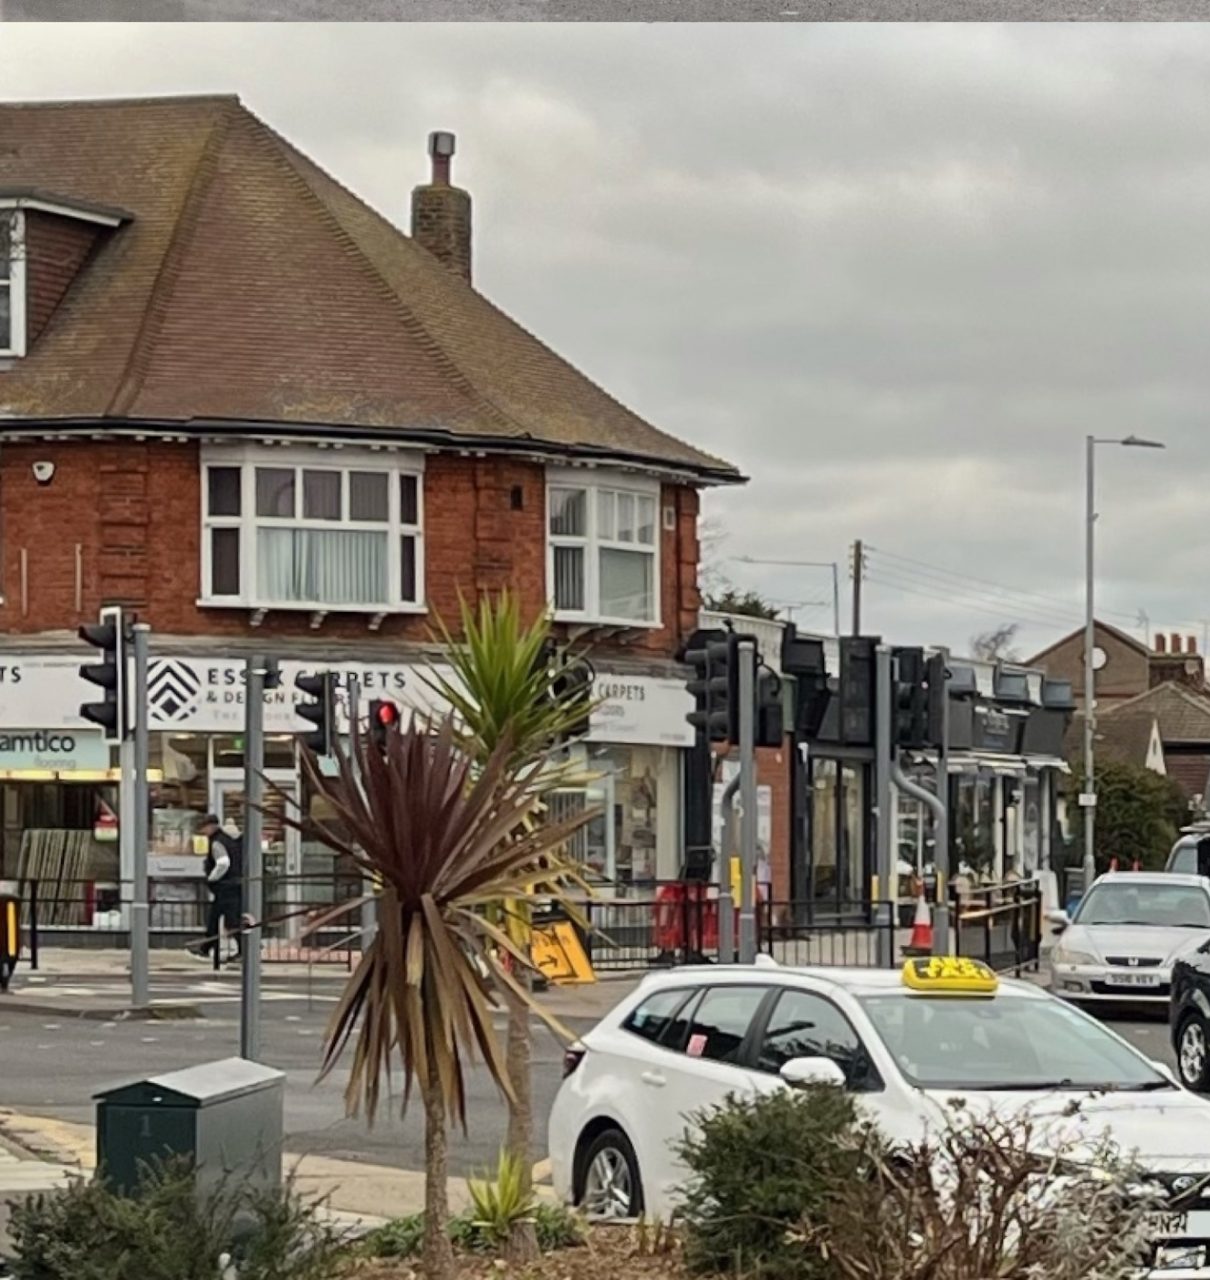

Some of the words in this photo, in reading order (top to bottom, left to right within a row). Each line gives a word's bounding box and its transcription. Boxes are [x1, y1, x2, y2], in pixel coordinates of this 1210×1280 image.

[206, 692, 217, 704] &
[224, 692, 286, 704] DEGN
[598, 683, 645, 701] CARPETS
